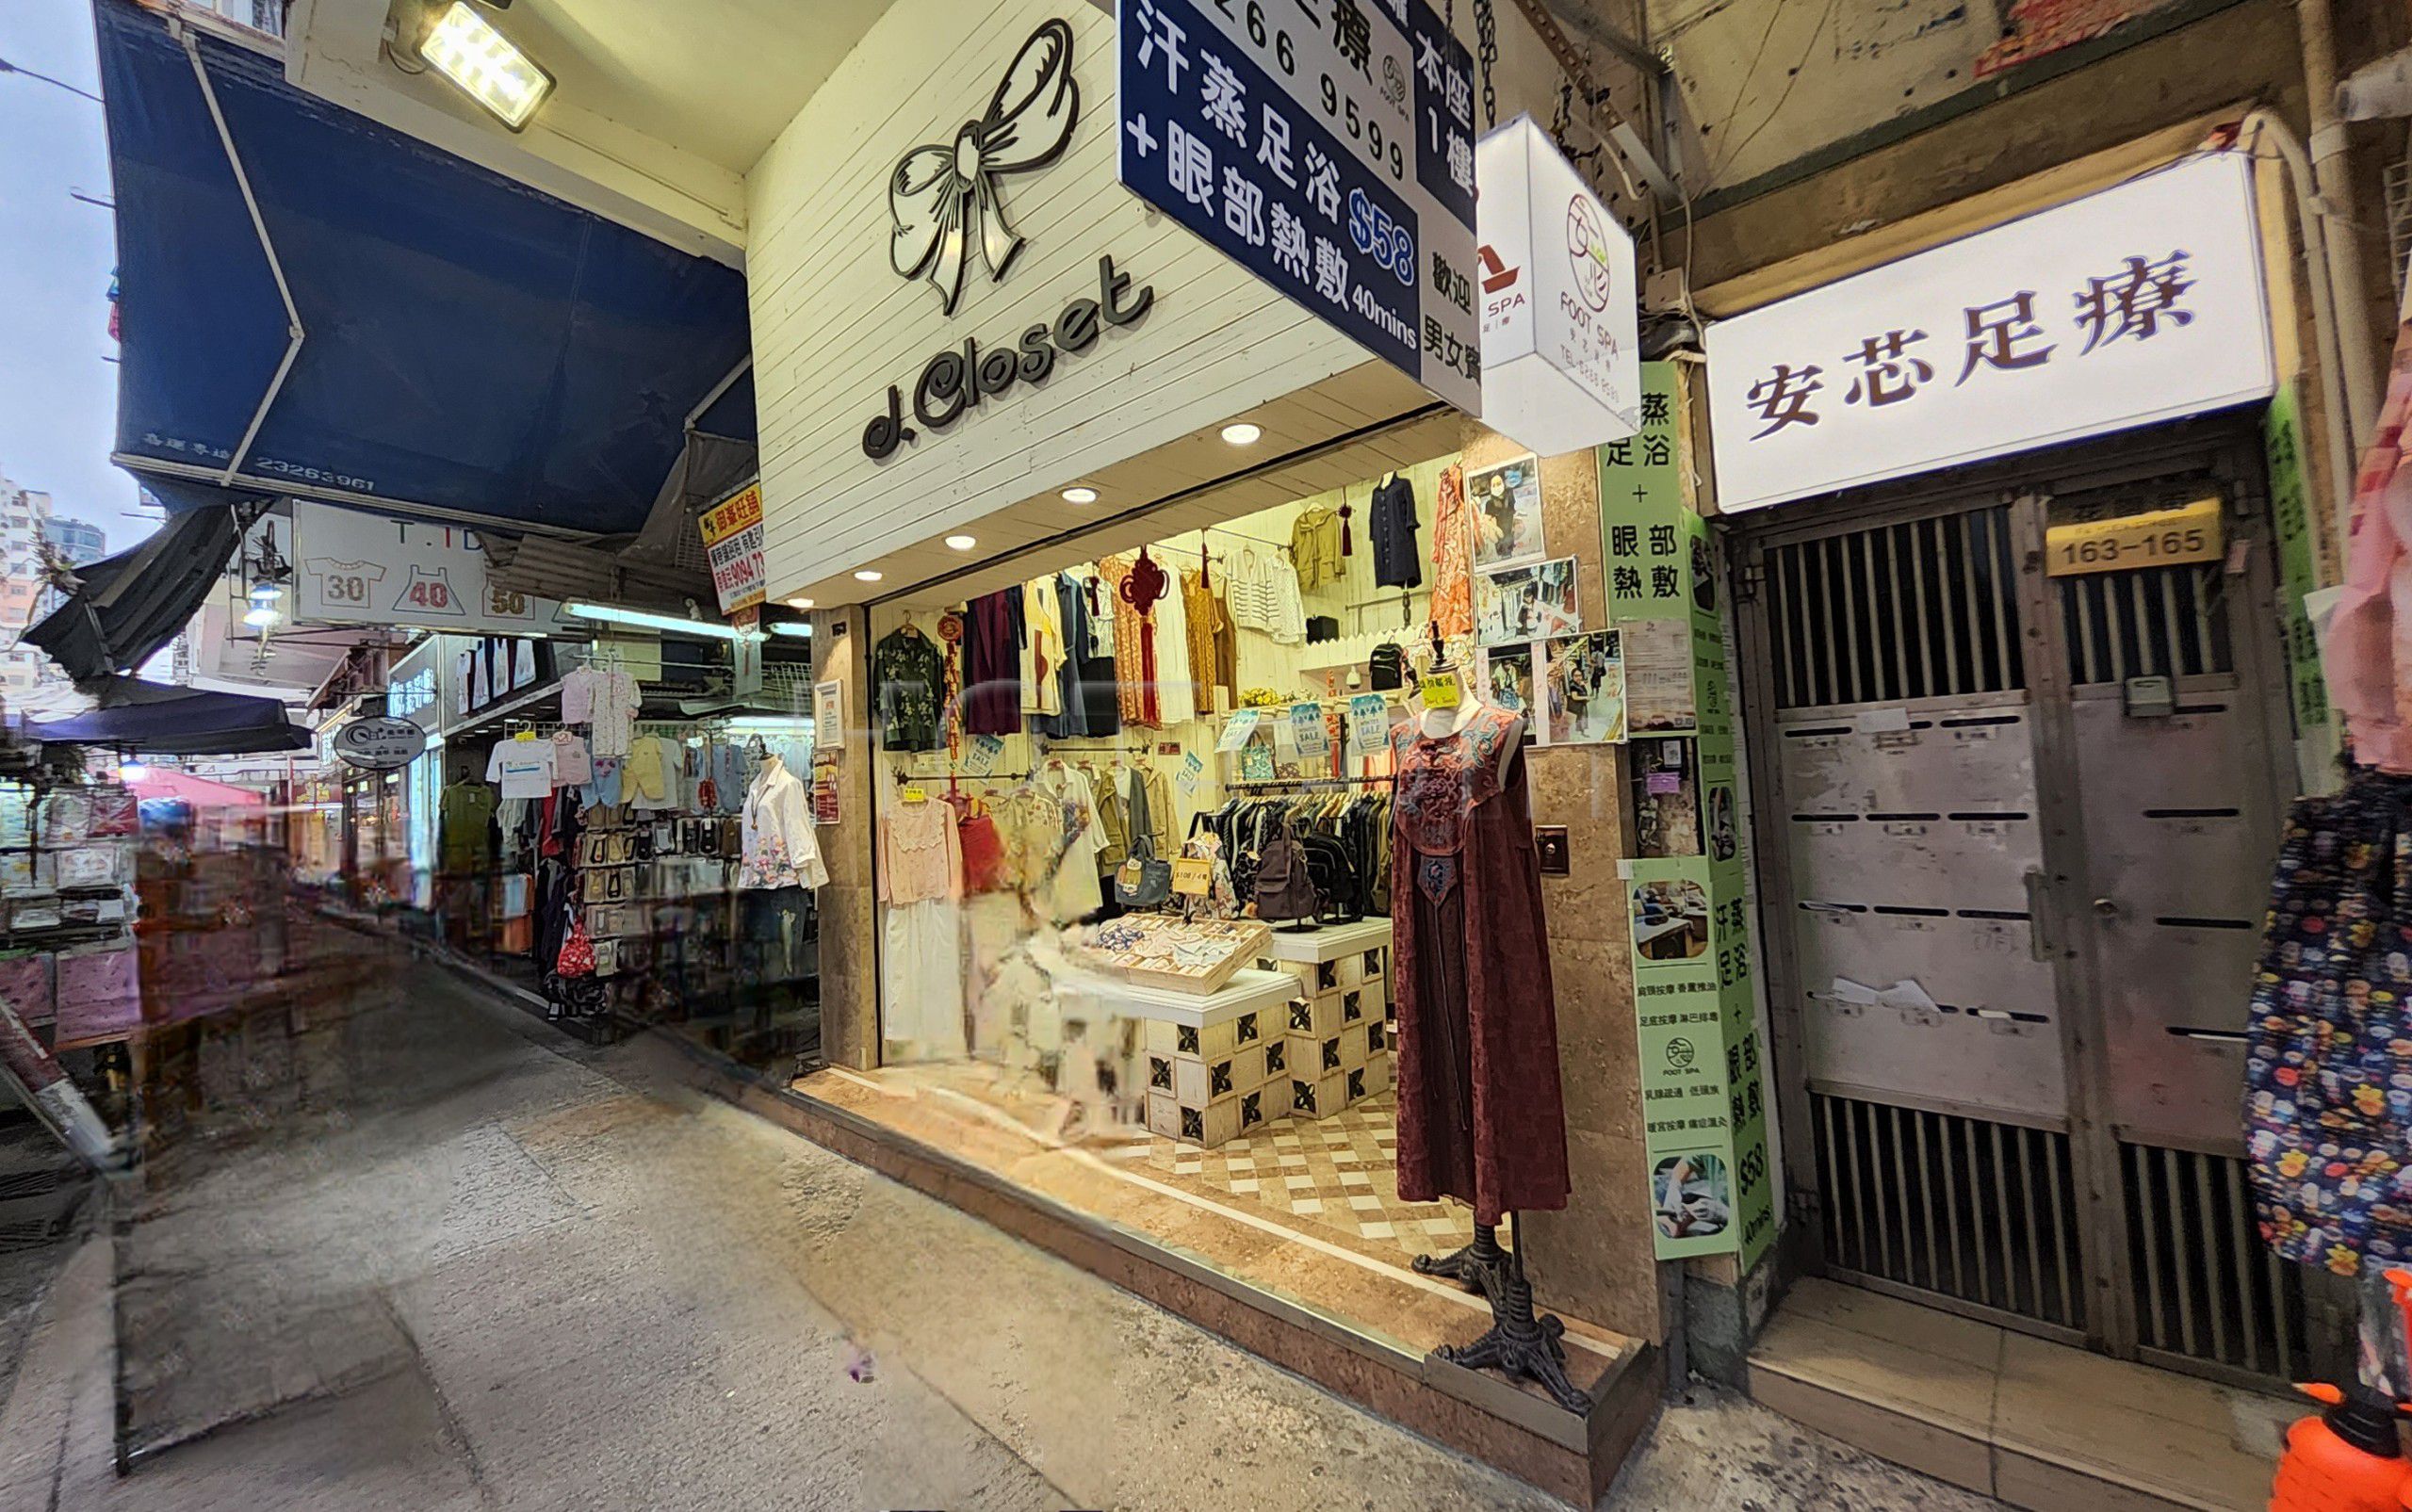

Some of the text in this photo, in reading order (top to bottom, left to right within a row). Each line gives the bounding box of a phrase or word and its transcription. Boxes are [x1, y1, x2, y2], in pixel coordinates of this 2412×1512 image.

[1415, 30, 1471, 130] 本座
[1135, 0, 1414, 286] 汗蒸足浴 $58
[1320, 73, 1404, 181] 9599
[1432, 252, 1472, 316] 歡迎
[1352, 285, 1416, 350] 40mins
[1488, 293, 1525, 317] SPA
[1560, 291, 1591, 333] FOOT
[1597, 324, 1619, 360] SPA
[1746, 249, 2199, 443] 安芯足療
[1641, 392, 1670, 426] 蒸
[1606, 434, 1670, 467] 足浴
[1612, 524, 1677, 557] 眼部
[2063, 529, 2206, 564] 163-165
[329, 575, 366, 602] 30
[409, 581, 448, 609] 40
[1613, 564, 1680, 599] 熱敷
[491, 591, 526, 615] 50
[1299, 731, 1321, 741] SALE
[1740, 1142, 1764, 1195] $58
